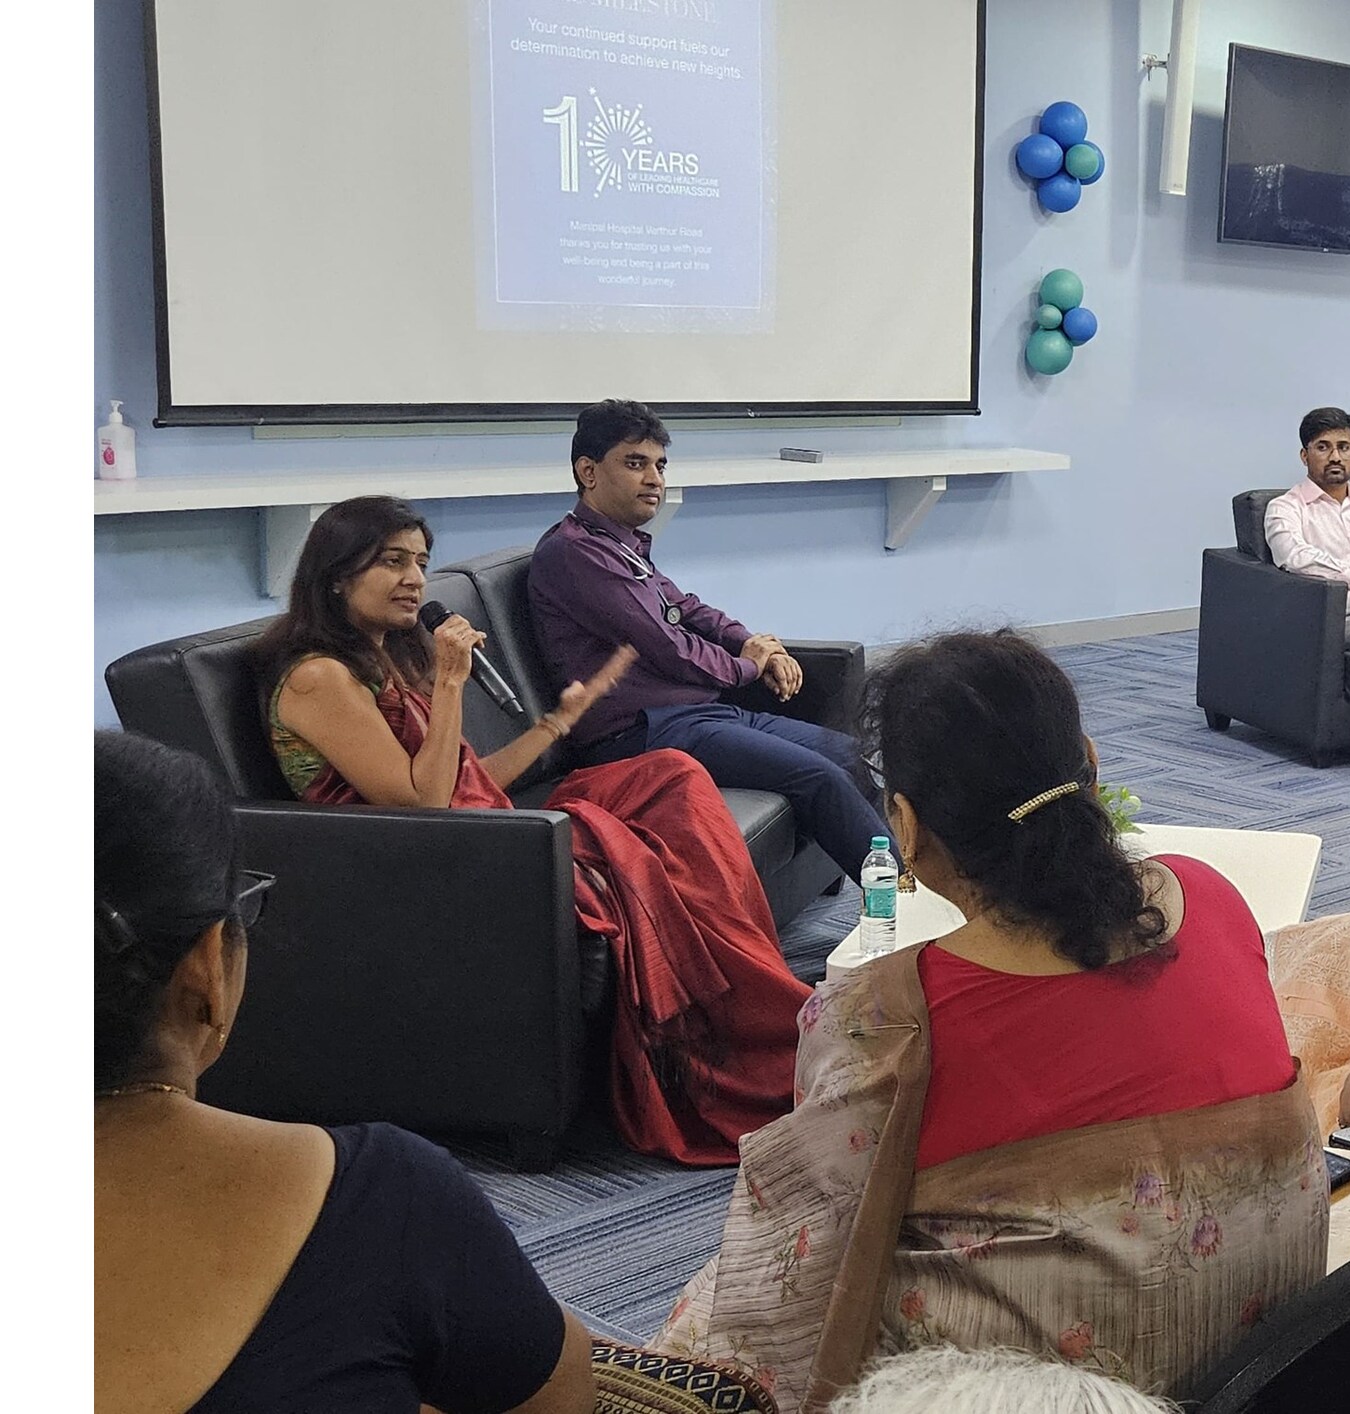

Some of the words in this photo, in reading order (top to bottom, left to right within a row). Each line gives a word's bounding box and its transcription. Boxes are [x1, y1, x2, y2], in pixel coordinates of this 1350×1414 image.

[527, 16, 558, 35] Your
[560, 21, 625, 44] continued
[628, 32, 677, 52] support
[680, 39, 708, 56] fuels
[710, 46, 731, 58] our
[510, 37, 600, 61] determination
[603, 50, 617, 63] to
[620, 53, 669, 70] achieve
[672, 60, 698, 73] new
[699, 61, 744, 81] heights.
[621, 147, 699, 175] YEARS
[627, 172, 637, 181] OF
[627, 181, 654, 193] WITH
[656, 184, 720, 198] COMPASSION
[592, 241, 609, 252] you
[610, 240, 623, 250] for
